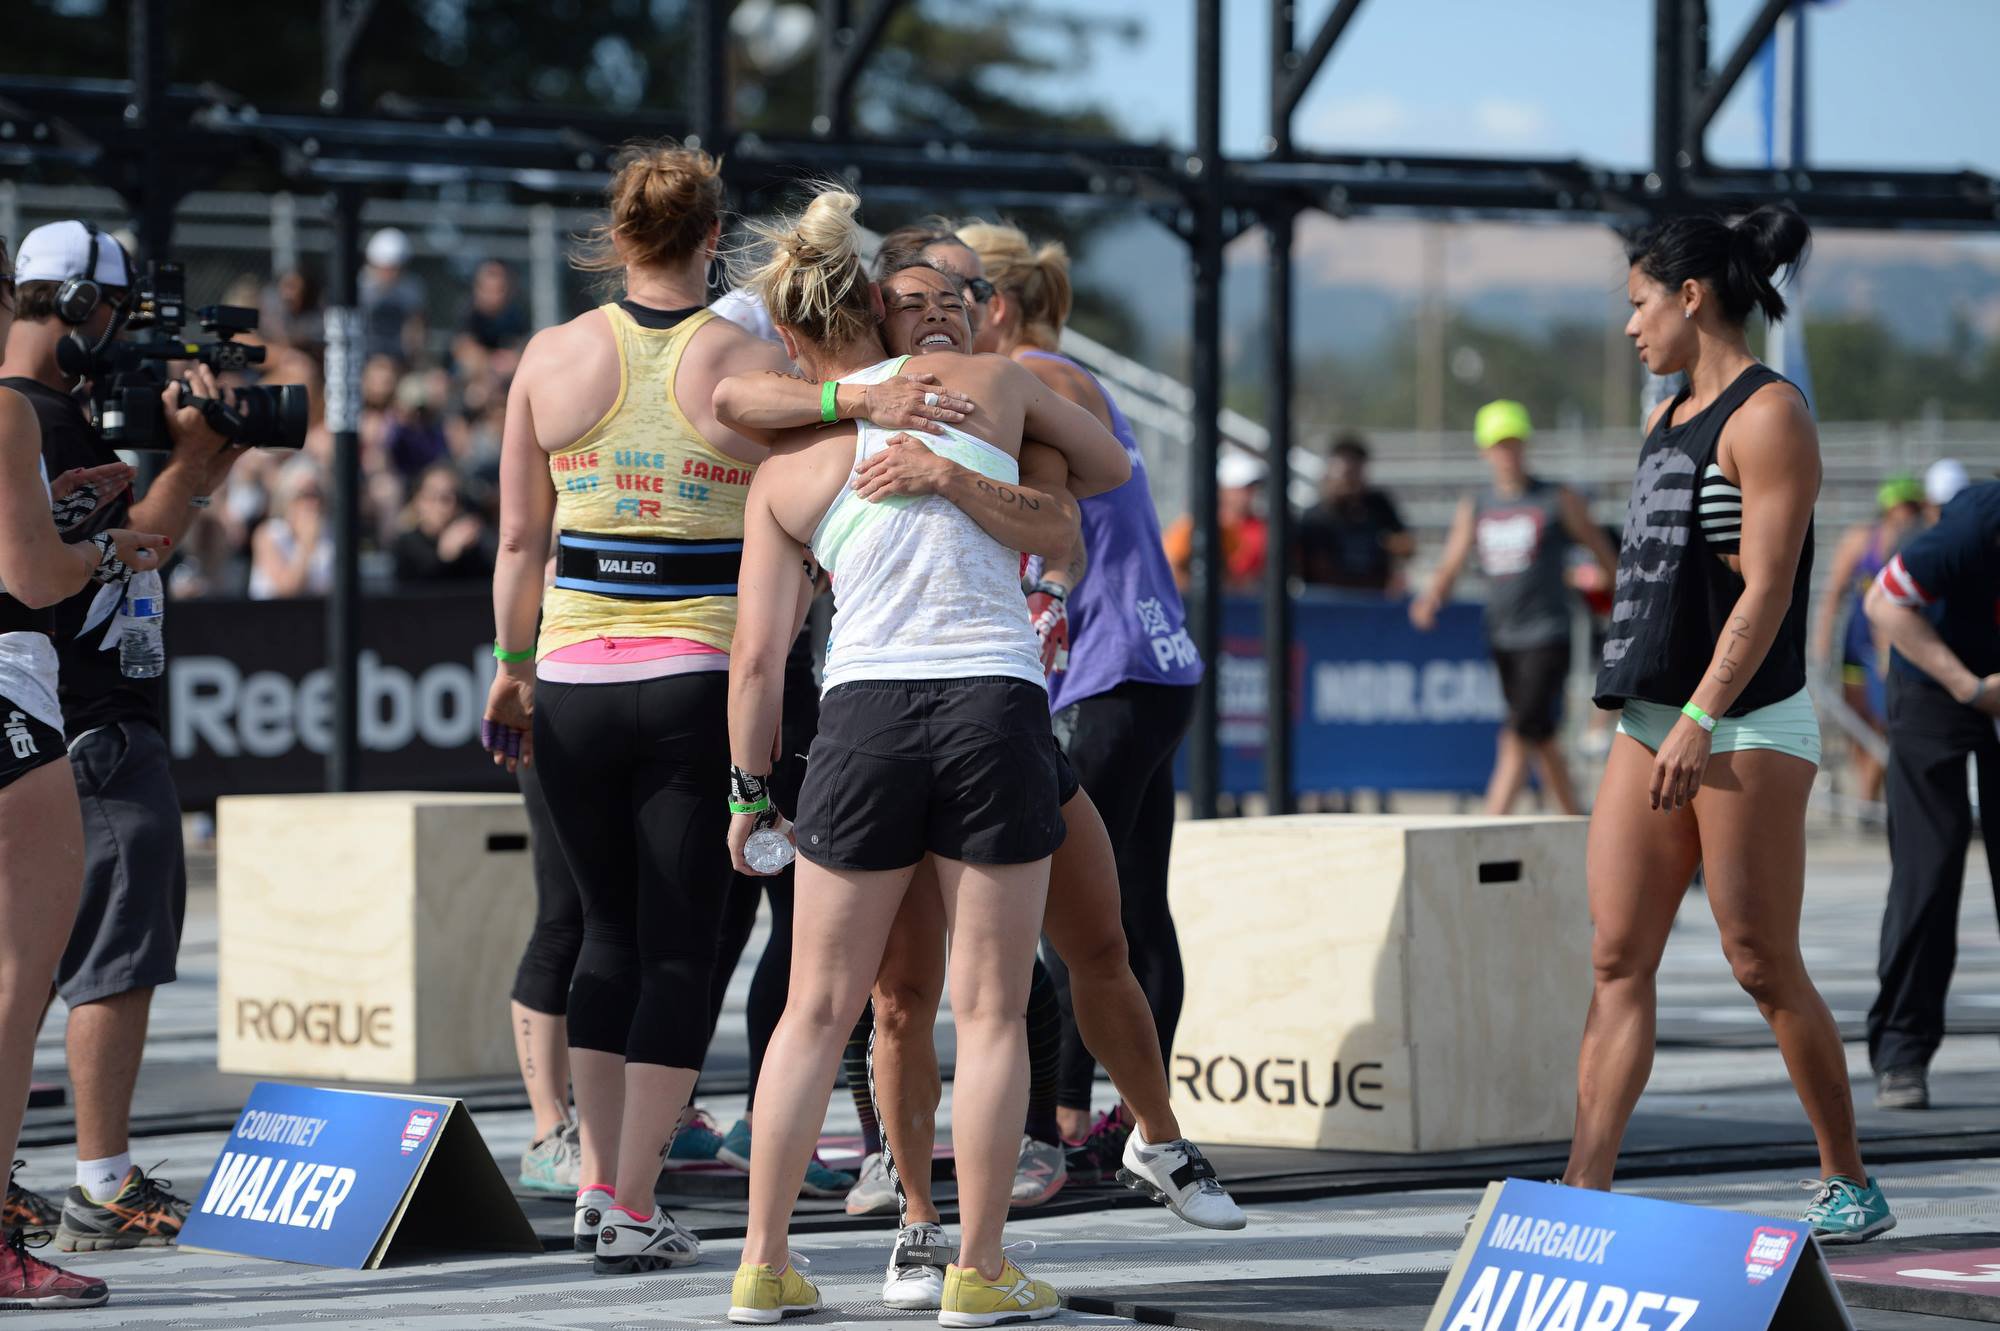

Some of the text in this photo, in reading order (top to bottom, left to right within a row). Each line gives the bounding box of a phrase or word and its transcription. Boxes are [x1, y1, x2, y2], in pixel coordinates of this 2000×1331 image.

[614, 450, 665, 469] LIKE
[615, 473, 664, 493] LIKE
[598, 559, 656, 575] VALEO
[168, 647, 497, 760] Reebo
[237, 999, 393, 1048] ROGUE
[1176, 1055, 1383, 1111] ROGUE
[237, 1109, 328, 1148] COURTNEY
[200, 1151, 357, 1231] WALKER
[1488, 1213, 1616, 1265] MARGAUX
